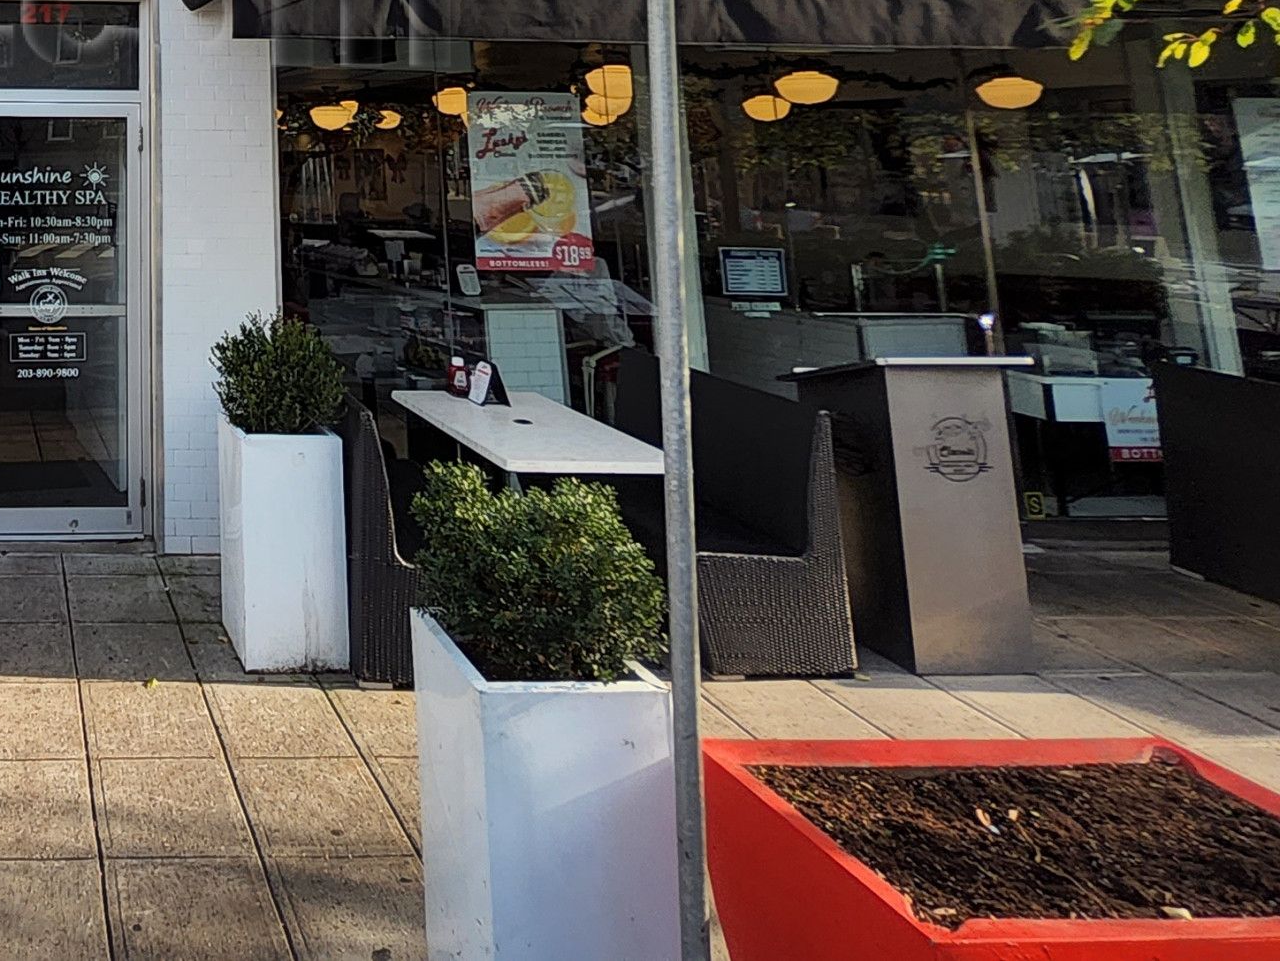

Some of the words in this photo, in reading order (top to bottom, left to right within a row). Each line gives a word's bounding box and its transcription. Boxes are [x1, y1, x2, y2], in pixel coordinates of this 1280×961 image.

[21, 3, 70, 24] 217
[75, 190, 108, 205] SPA
[30, 216, 113, 230] 10:30am-8:30pm
[489, 260, 550, 268] BOTTOMLESS!
[8, 270, 31, 284] Walk
[49, 267, 87, 284] Welcome
